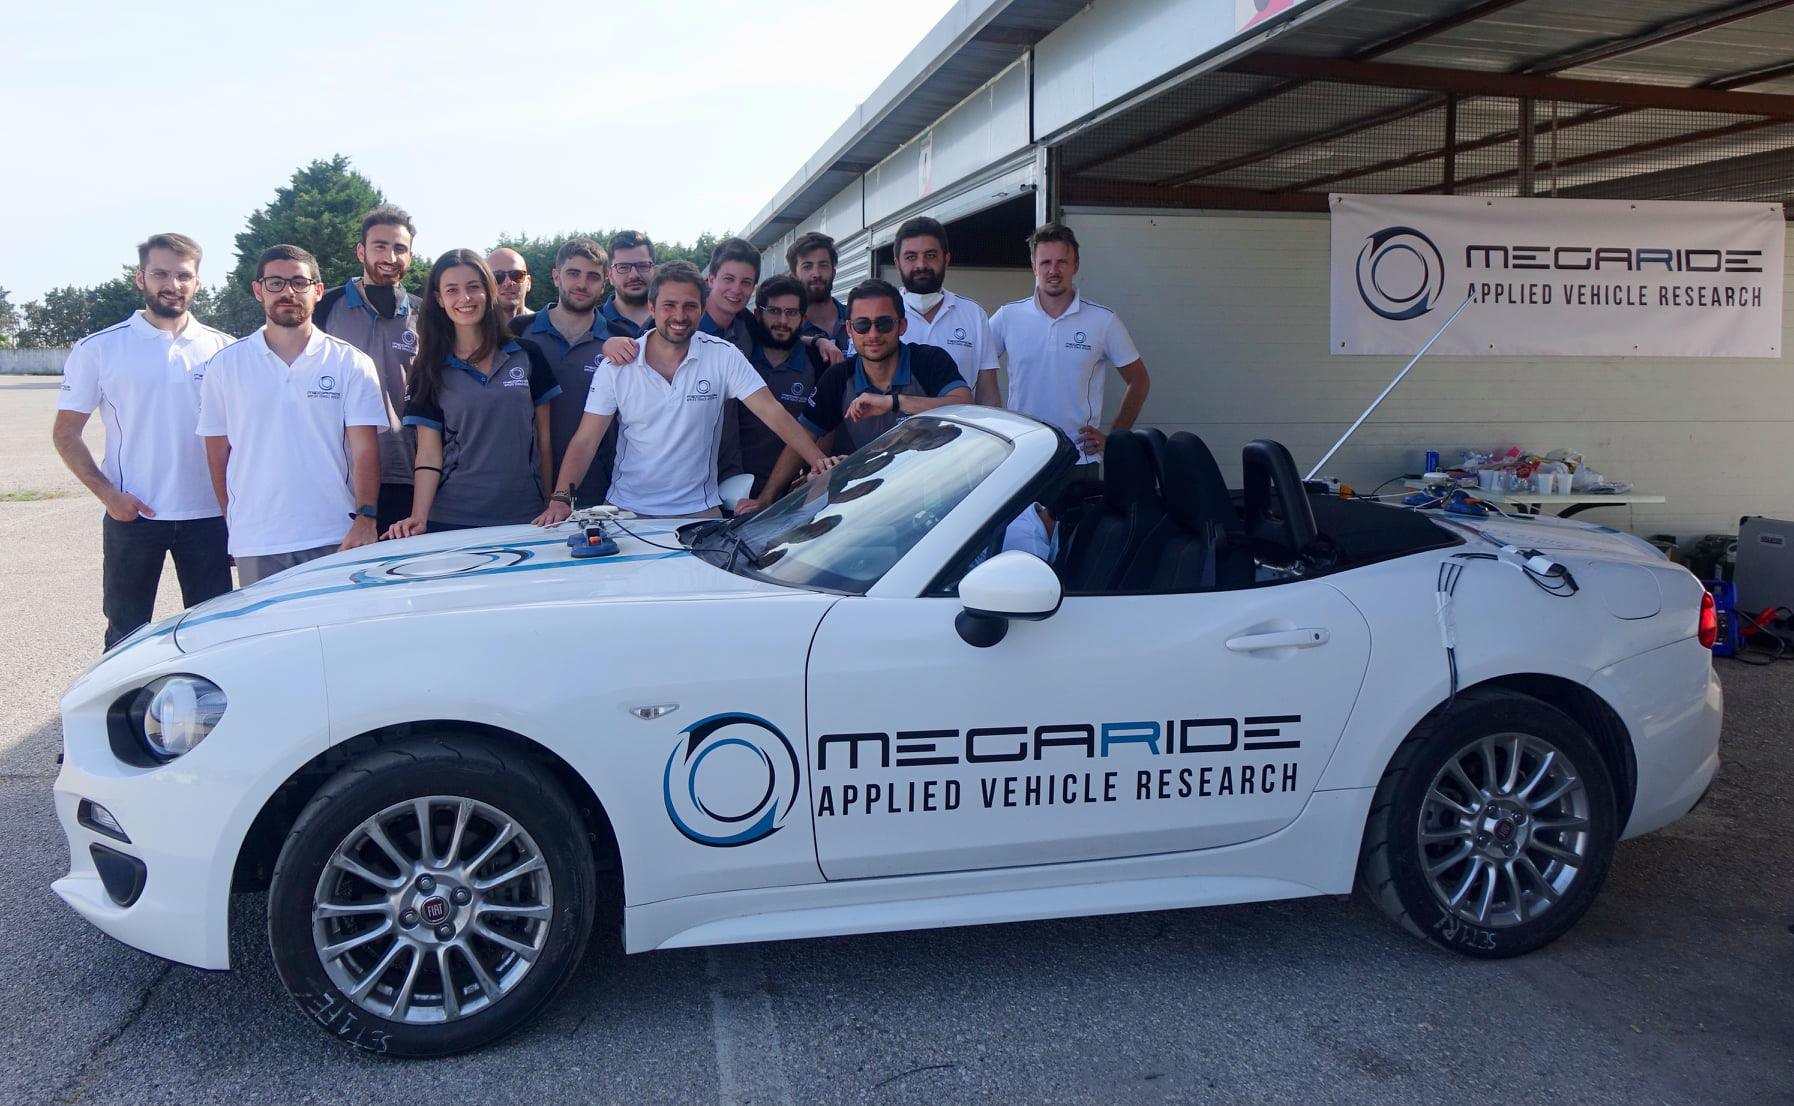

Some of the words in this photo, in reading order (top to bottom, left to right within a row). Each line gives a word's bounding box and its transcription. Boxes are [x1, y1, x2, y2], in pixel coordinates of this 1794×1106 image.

[1466, 245, 1763, 273] MEGARIDE
[1467, 282, 1552, 305] APPLIED
[1563, 284, 1648, 306] VEHICLE
[1659, 286, 1761, 307] RESEARCH
[818, 715, 1301, 770] MEGARIDE
[817, 780, 961, 817] APPLIED
[981, 771, 1118, 808] VEHICLE
[1136, 763, 1298, 800] RESEARCH
[427, 903, 443, 918] FIAT
